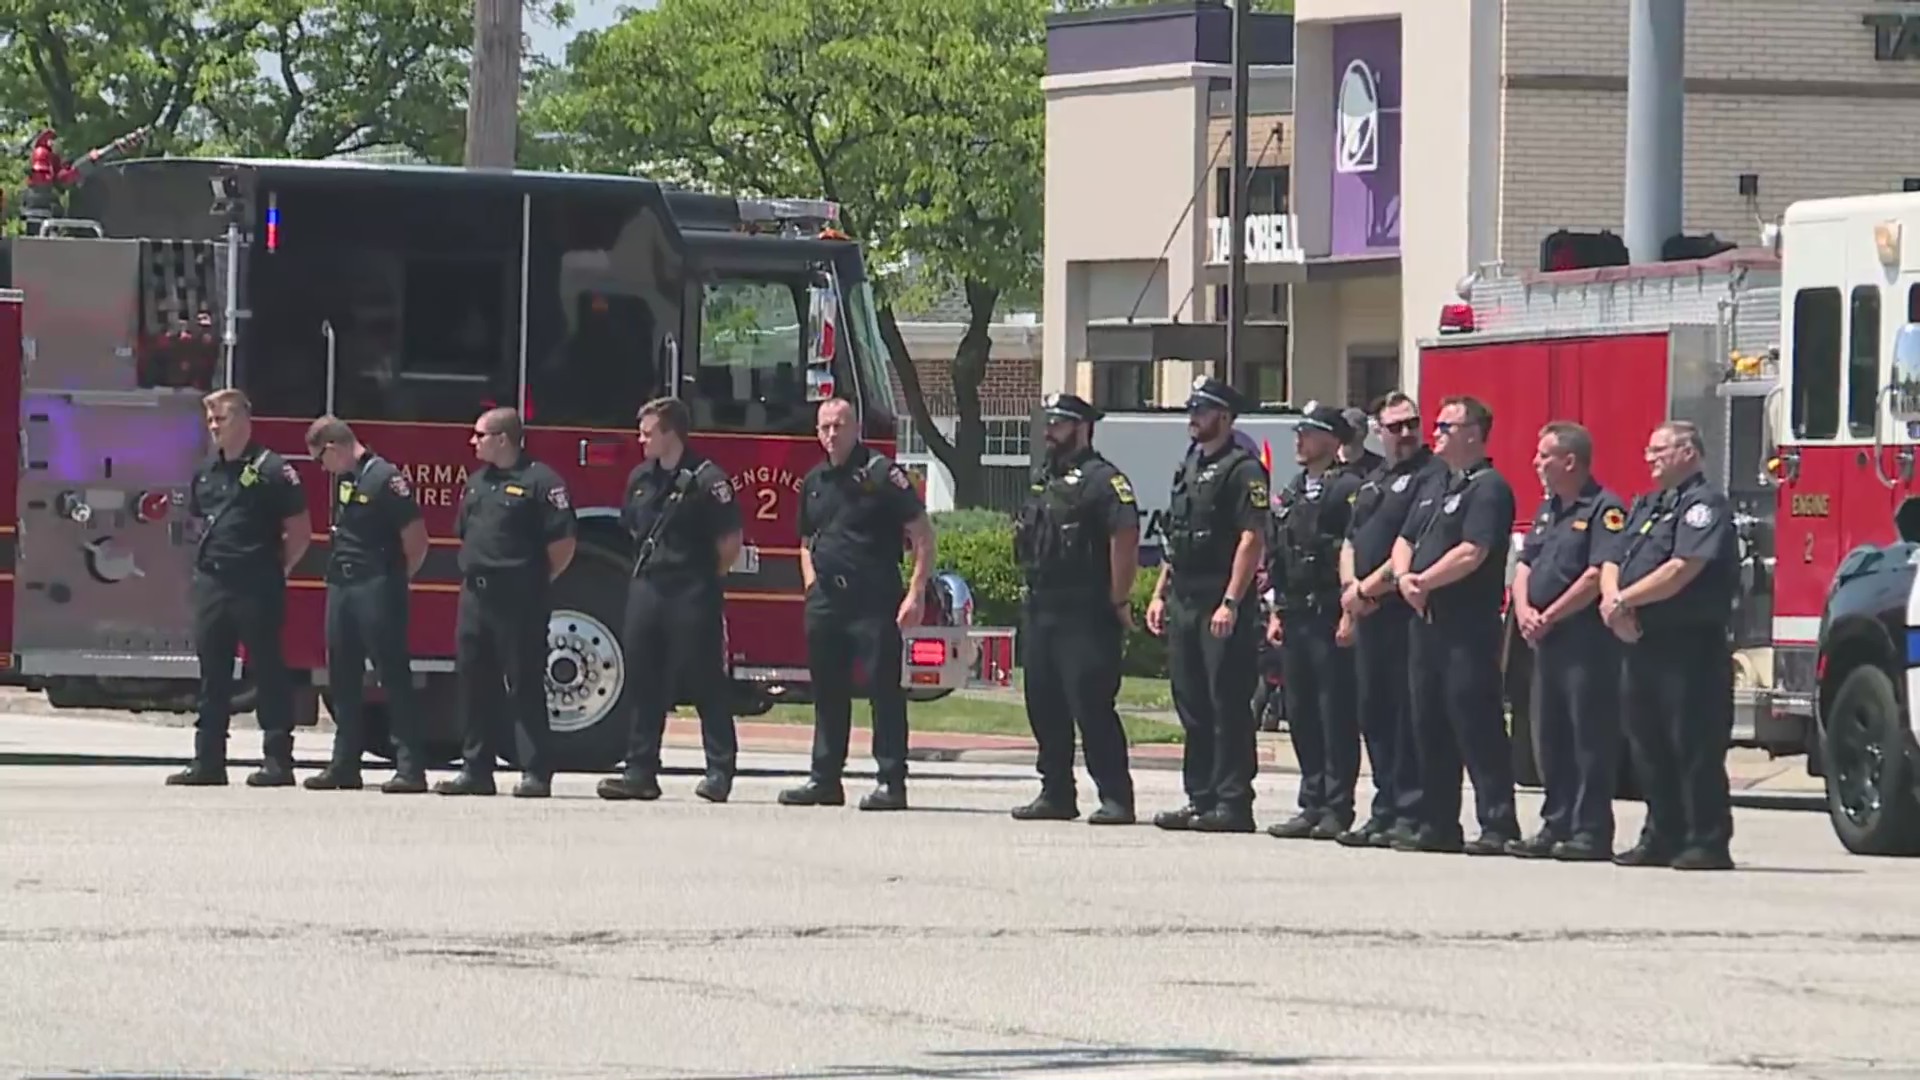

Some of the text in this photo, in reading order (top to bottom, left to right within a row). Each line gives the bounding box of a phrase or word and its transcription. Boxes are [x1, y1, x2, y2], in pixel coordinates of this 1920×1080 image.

[401, 464, 468, 484] ARMA
[731, 466, 804, 493] ENGINE
[415, 487, 452, 506] IRE
[756, 488, 778, 519] 2
[1792, 494, 1829, 515] ENGINE
[1804, 532, 1814, 561] 2
